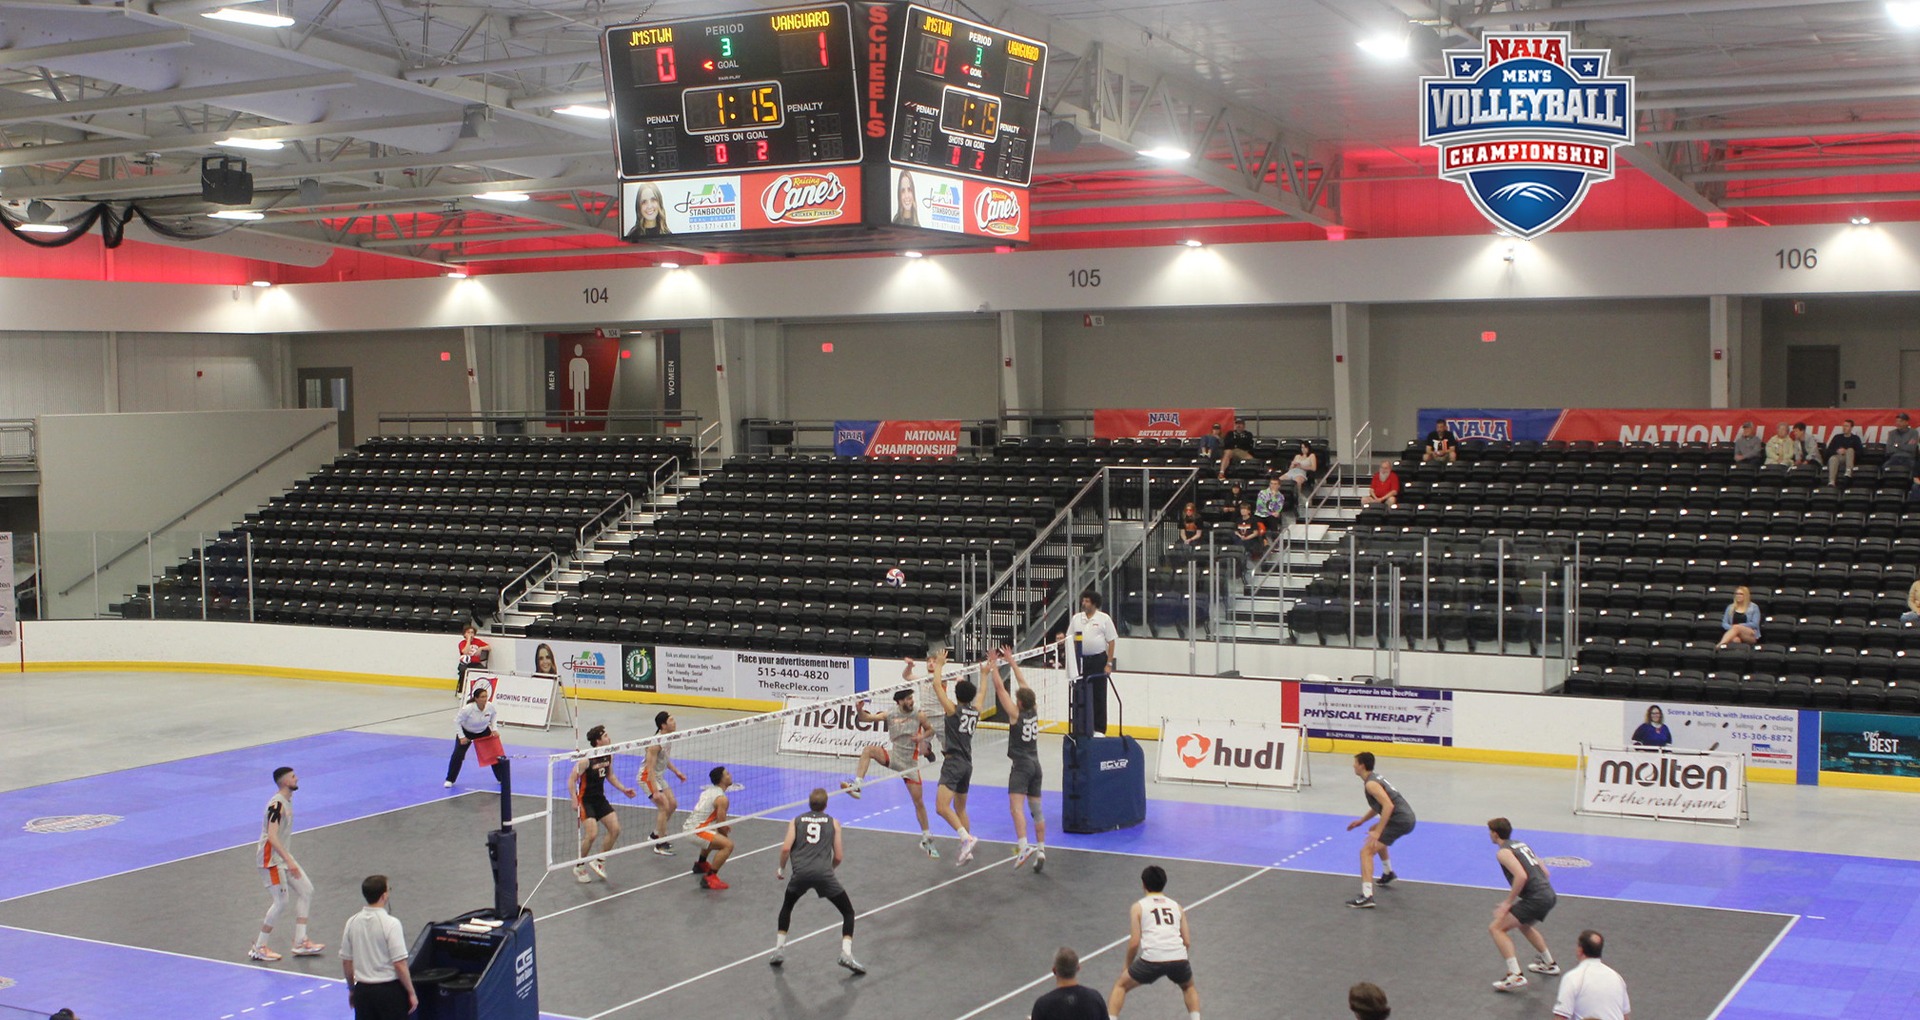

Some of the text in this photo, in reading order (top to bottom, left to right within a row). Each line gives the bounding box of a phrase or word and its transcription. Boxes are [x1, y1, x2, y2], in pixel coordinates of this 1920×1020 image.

[771, 11, 830, 32] VANGUARD
[629, 28, 673, 46] JMSTWN
[705, 24, 744, 37] PERIOD
[720, 37, 731, 57] 3
[968, 32, 992, 46] PERIOD
[818, 32, 829, 67] 1
[933, 39, 949, 75] 0
[974, 46, 983, 65] 3
[655, 47, 677, 82] 0
[717, 60, 739, 70] GOAL
[866, 5, 889, 139] SCHEELS
[969, 67, 983, 78] GOAL
[1025, 66, 1034, 96] 1
[717, 87, 779, 125] 1:15
[787, 102, 823, 113] PENALTY
[915, 104, 940, 117] PENALTY
[646, 115, 680, 125] PENALTY
[999, 122, 1020, 134] PENALTY
[704, 130, 768, 144] SHOTS ON GOAL
[948, 135, 986, 150] SHOTS ON GOAL
[715, 143, 729, 164] 0
[757, 141, 769, 160] 2
[974, 151, 985, 170] 2
[689, 206, 736, 217] STANBROUGH
[1775, 248, 1817, 270] 106
[1068, 268, 1101, 288] 105
[582, 287, 609, 304] 104
[1147, 412, 1181, 427] NAIA
[838, 430, 865, 445] NAIA
[905, 430, 957, 441] NATIONAL
[1446, 419, 1511, 442] NAIA
[874, 444, 957, 455] CHAMPIONSHIP
[737, 653, 850, 669] Place your advertisement here!
[757, 667, 830, 681] 515-440-4820
[758, 680, 829, 692] TheRecPlex.com
[1348, 688, 1372, 696] partner
[496, 693, 521, 703] GROWING
[521, 695, 531, 704] THE
[1303, 709, 1422, 724] PHYSICAL THERAPY
[1705, 710, 1722, 718] Trick
[1722, 711, 1738, 719] with
[958, 714, 978, 736] 20
[788, 731, 808, 743] For
[808, 732, 828, 744] the
[833, 735, 855, 747] real
[1731, 732, 1793, 742] 515-306-8872
[1870, 738, 1900, 754] BEST
[1213, 738, 1285, 771] hudl
[1598, 758, 1728, 790] molten
[1592, 790, 1727, 813] For the real game
[806, 823, 821, 844] 9
[1150, 908, 1175, 926] 15
